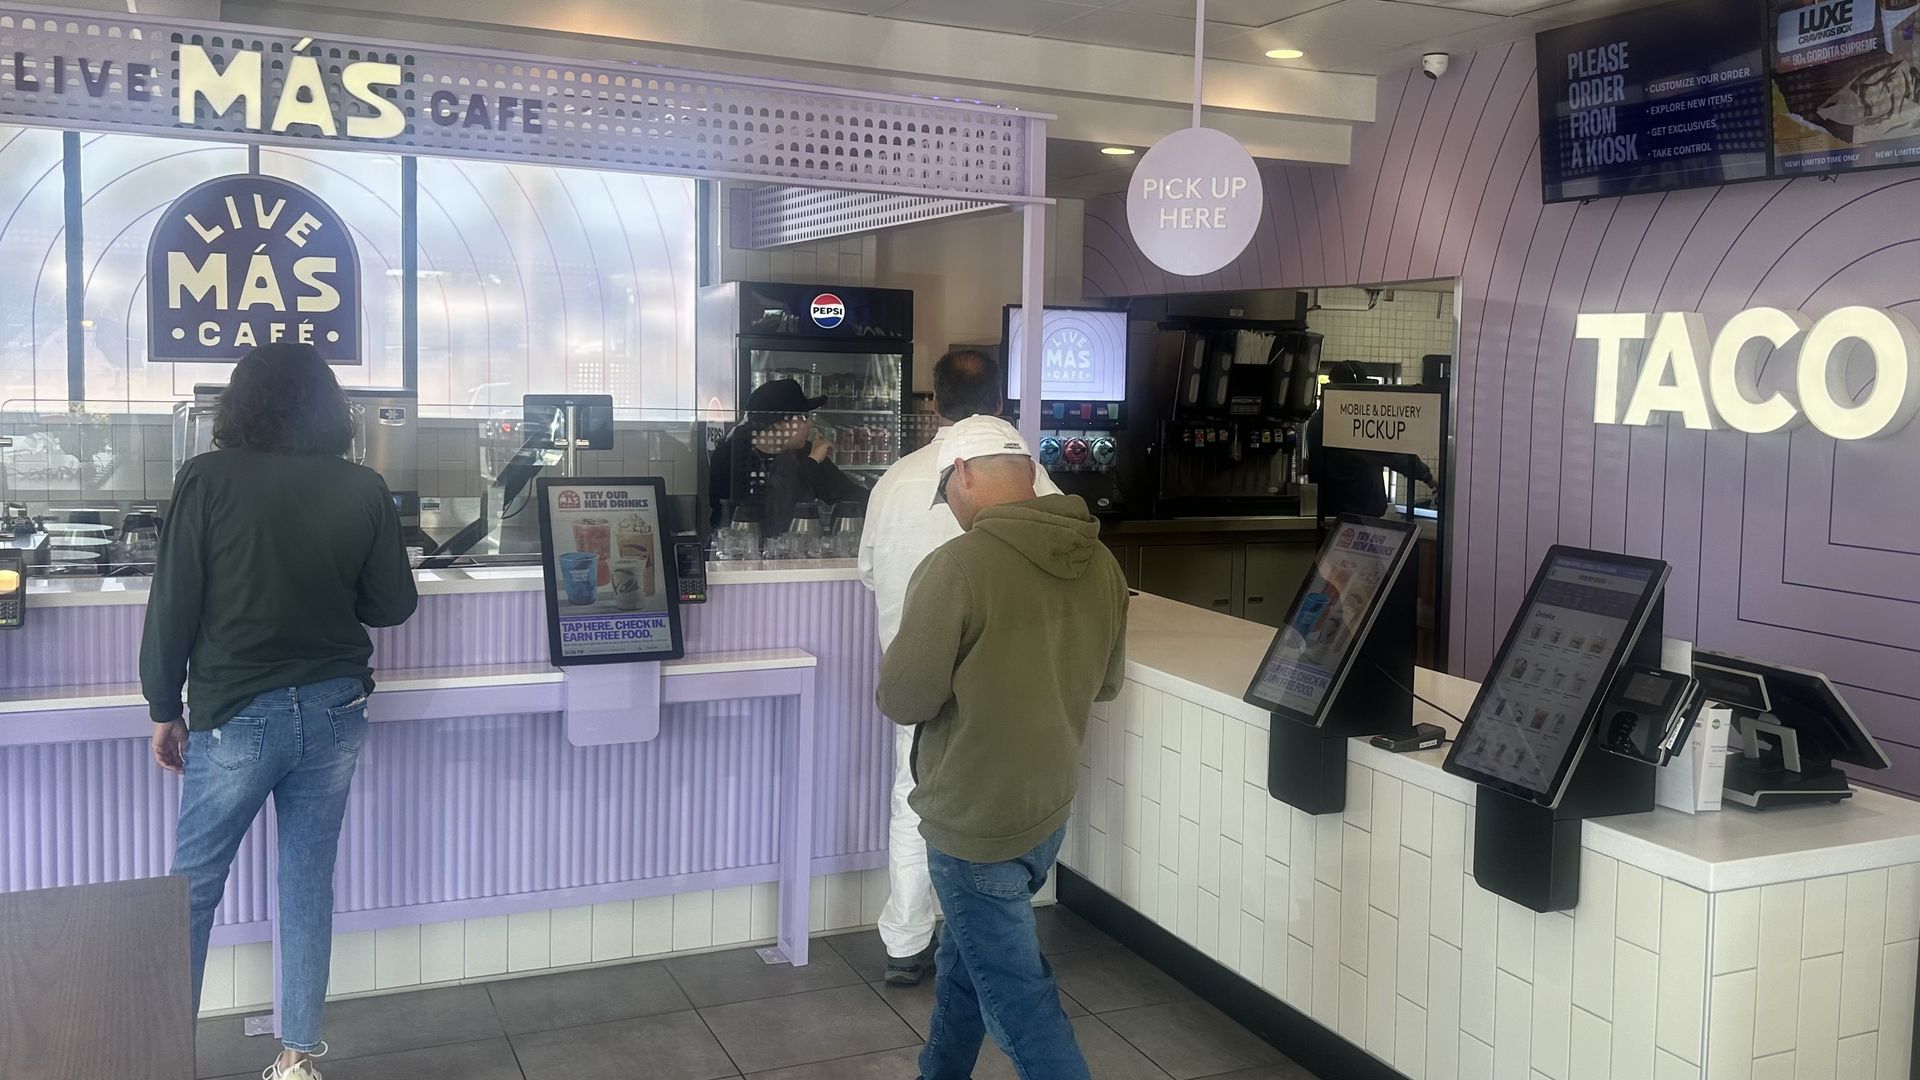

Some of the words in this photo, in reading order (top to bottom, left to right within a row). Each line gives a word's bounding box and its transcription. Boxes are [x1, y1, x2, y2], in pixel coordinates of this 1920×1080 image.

[1799, 0, 1852, 35] LUXE
[1798, 28, 1836, 44] CRAVINGS
[1836, 24, 1852, 34] BOX
[1568, 42, 1629, 80] PLEASE
[1808, 46, 1840, 63] GORDITA
[1840, 38, 1878, 56] SUPREME
[14, 52, 150, 100] LIVE
[179, 37, 406, 139] MÁS
[430, 90, 543, 134] CAFE
[1650, 78, 1694, 93] CUSTOMIZE
[1696, 74, 1718, 84] YOUR
[1720, 68, 1750, 80] ORDER
[1568, 74, 1625, 110] ORDER
[1650, 101, 1686, 115] EXPLORE
[1688, 98, 1706, 108] NEW
[1708, 94, 1733, 106] ITEMS
[1570, 106, 1616, 139] FROM
[1652, 126, 1666, 136] GET
[1668, 119, 1716, 134] EXCLUSIVES
[1572, 142, 1582, 168] A
[1586, 134, 1638, 166] KIOSK
[1652, 148, 1672, 158] TAKE
[1674, 142, 1712, 156] CONTROL
[1802, 158, 1826, 166] LIMITED
[1843, 154, 1860, 162] ONLY
[1143, 178, 1202, 200] PICK
[1211, 176, 1247, 198] UP
[184, 194, 323, 248] LIVE
[1160, 207, 1227, 229] HERE
[168, 244, 340, 312] MÁS
[813, 306, 842, 315] PEPSI
[198, 318, 314, 346] CAFÉ
[1052, 331, 1087, 348] LIVE
[1575, 306, 1908, 440] TACO
[1340, 404, 1370, 416] MOBILE
[1372, 405, 1378, 416] &
[1380, 405, 1421, 418] DELIVERY
[1352, 419, 1406, 440] PICKUP
[584, 491, 603, 499] TRY
[606, 490, 628, 499] OUR
[584, 500, 610, 508] NEW
[610, 499, 648, 508] DRINKS
[562, 622, 582, 632] TAP
[584, 621, 614, 632] HERE.
[616, 620, 651, 630] CHECK
[652, 618, 666, 628] IN.
[563, 632, 592, 642] EARN
[595, 630, 620, 640] FREE
[622, 630, 653, 640] FOOD.
